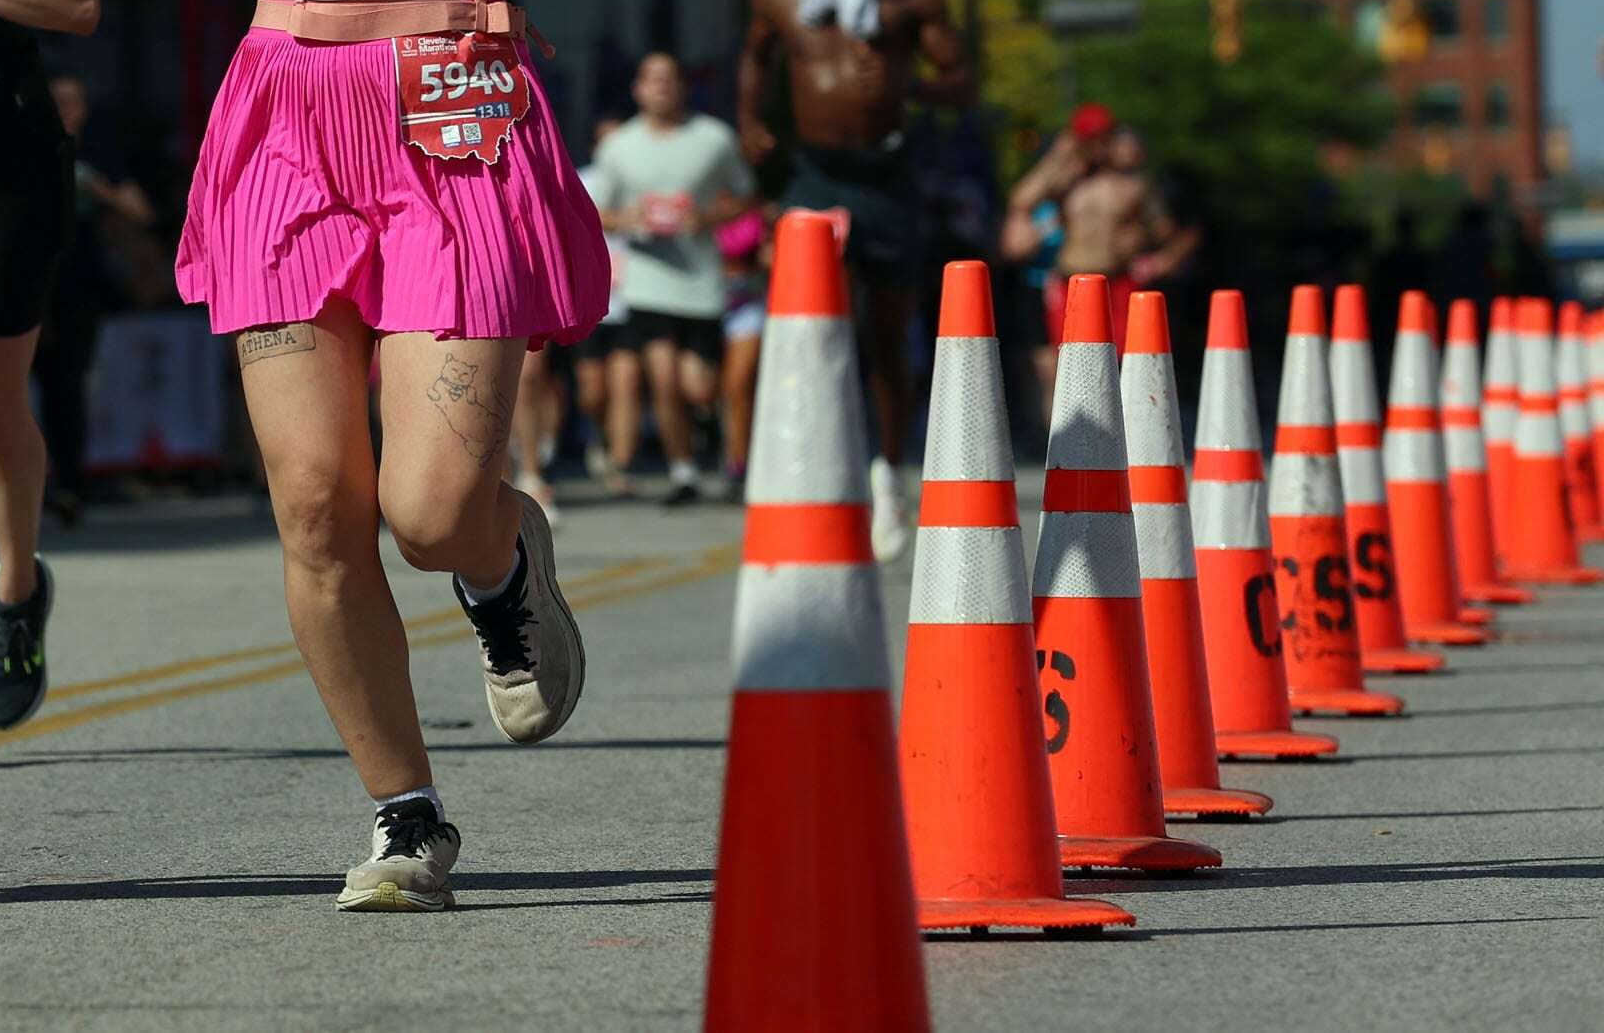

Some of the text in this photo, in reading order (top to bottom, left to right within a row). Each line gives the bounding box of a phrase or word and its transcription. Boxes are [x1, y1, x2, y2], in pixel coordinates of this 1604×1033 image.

[419, 44, 457, 53] Marathon
[420, 60, 514, 102] 5940
[478, 104, 504, 118] 13.1
[242, 331, 297, 357] ATHENA
